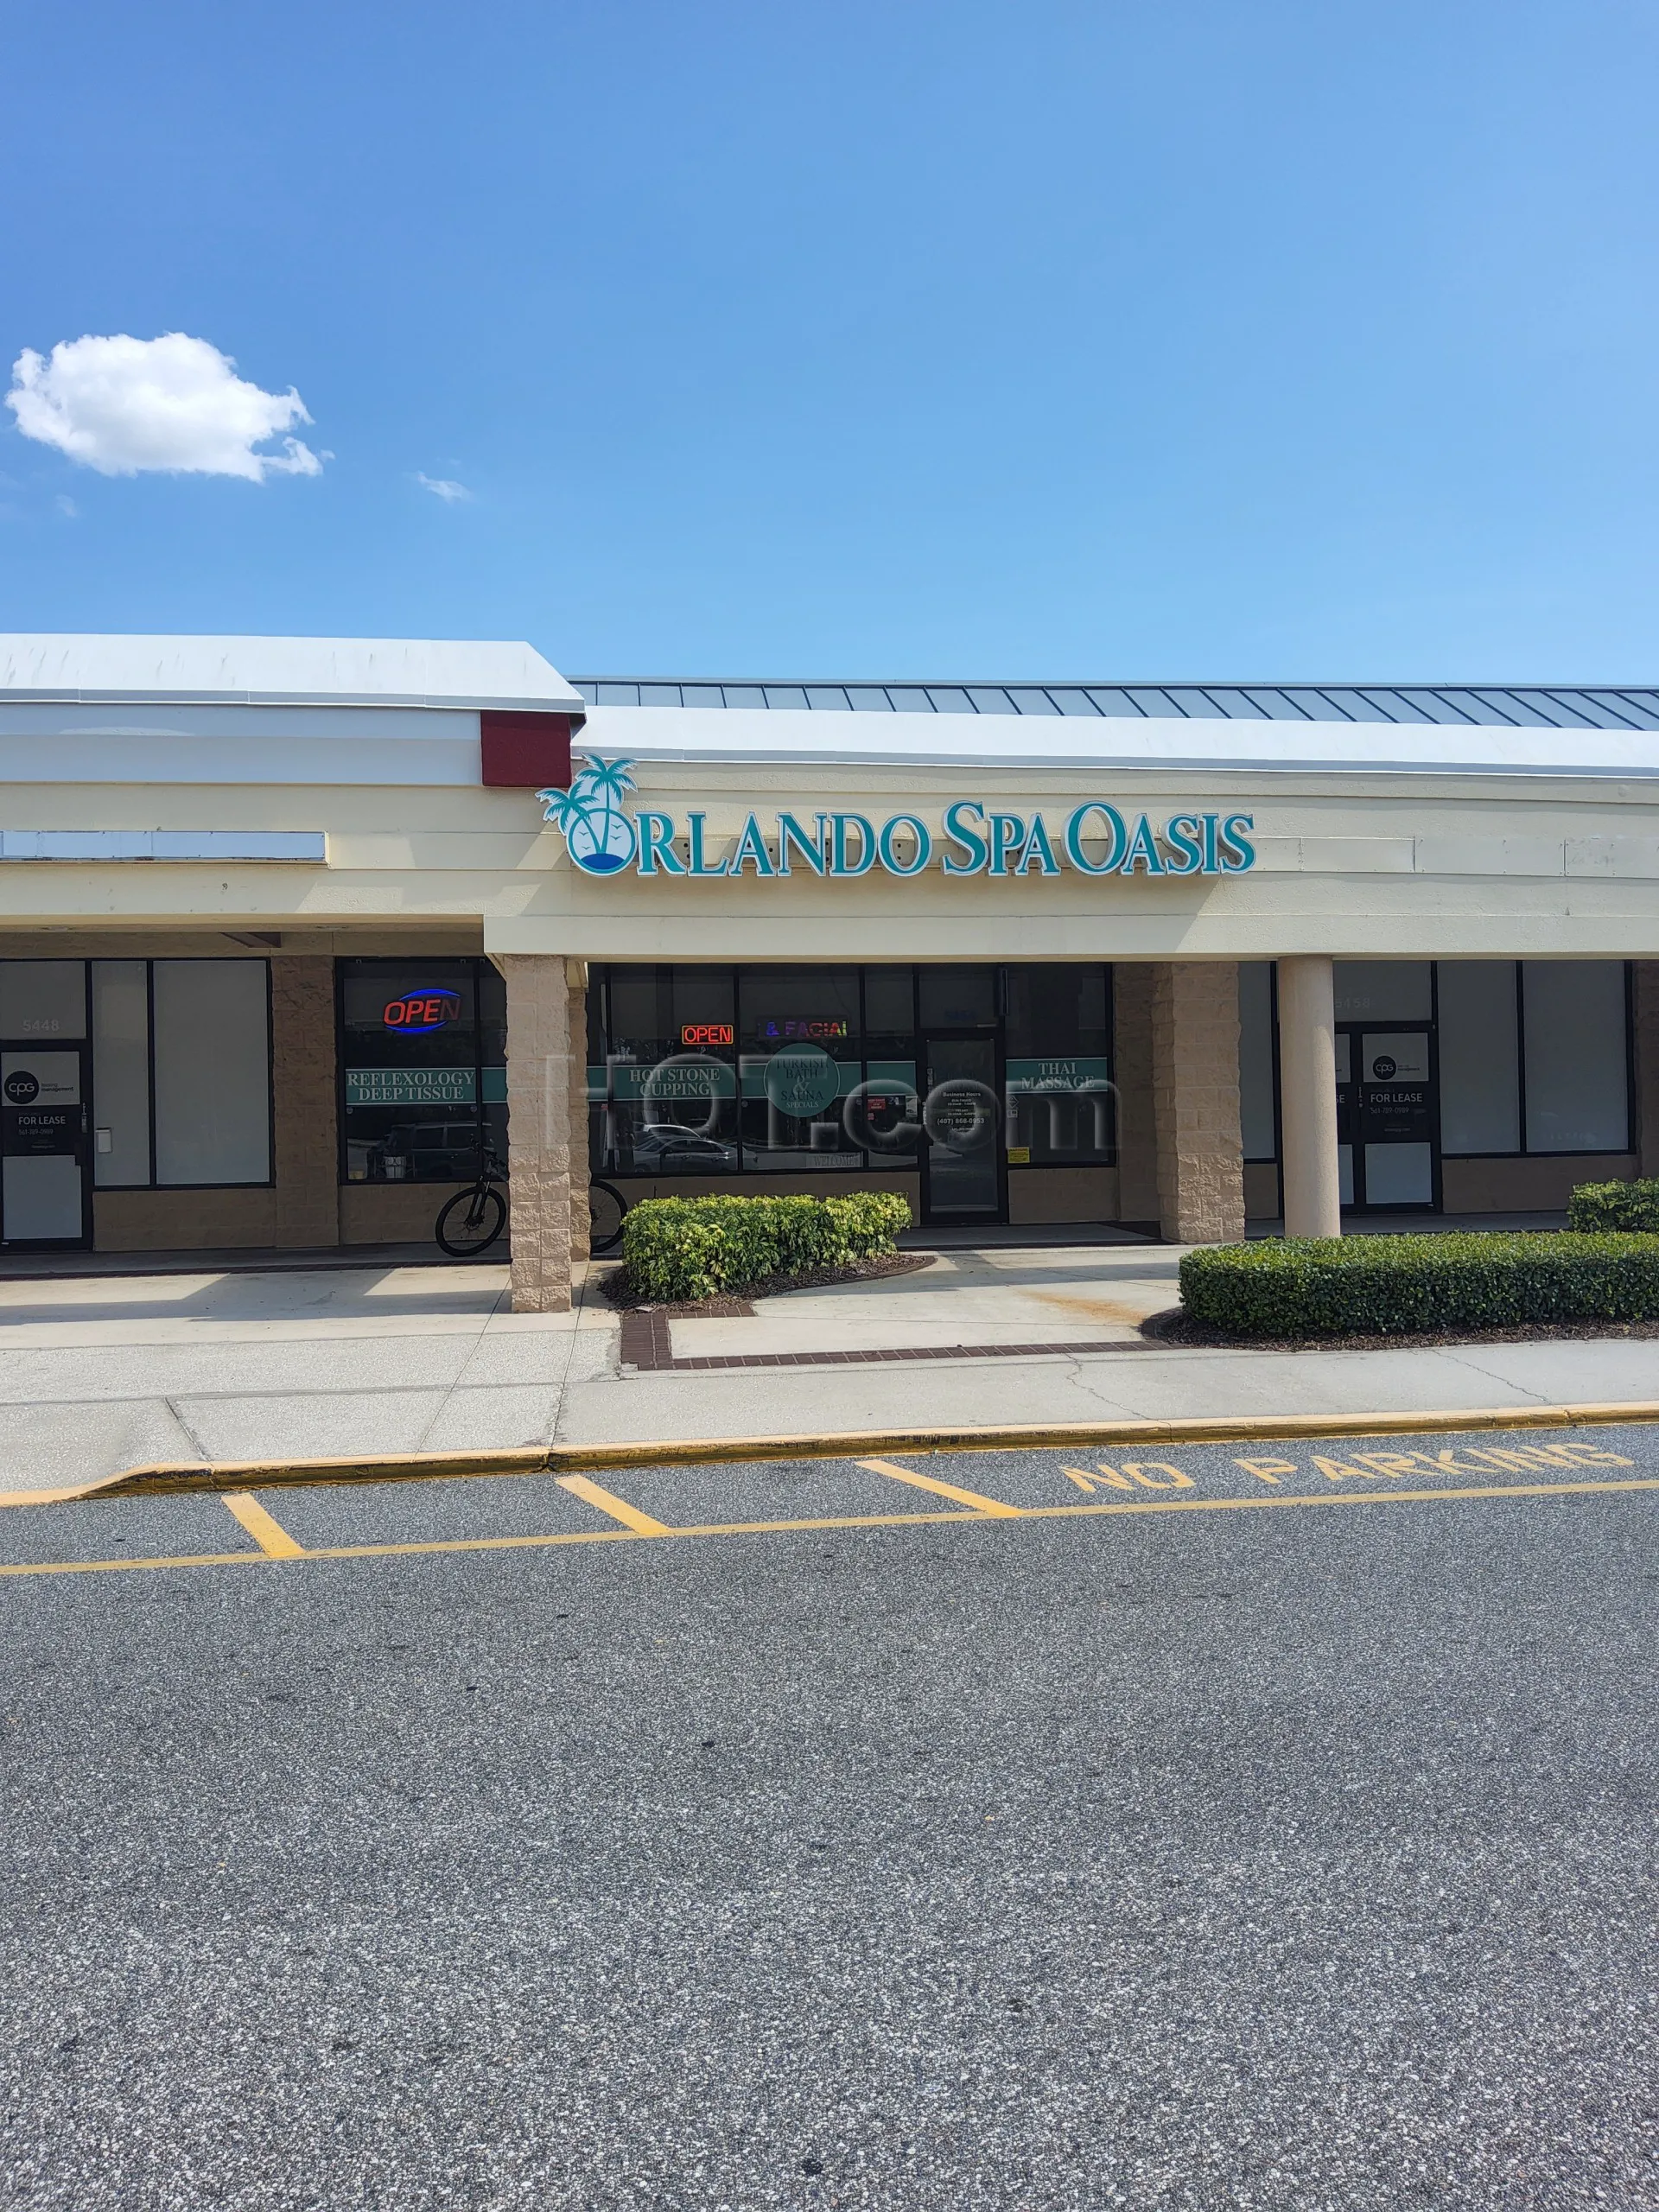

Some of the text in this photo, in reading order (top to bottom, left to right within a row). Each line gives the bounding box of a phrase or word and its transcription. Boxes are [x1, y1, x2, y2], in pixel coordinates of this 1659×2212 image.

[942, 799, 1062, 878] SPA
[1062, 798, 1258, 877] OASIS
[383, 999, 461, 1025] OPEN
[22, 1020, 60, 1032] 5448
[684, 1027, 732, 1043] OPEN
[775, 1058, 830, 1069] TURKISH
[1038, 1062, 1077, 1075] THAI
[347, 1071, 474, 1086] REFLEXOLOGY
[630, 1068, 721, 1082] HOT STONE
[785, 1068, 817, 1079] BATH
[639, 1082, 711, 1096] CUPPING
[1020, 1075, 1095, 1090] MASSAGE
[359, 1086, 464, 1101] DEEP TISSUE
[780, 1090, 824, 1101] SAUNA
[1370, 1093, 1423, 1103] FOR LEASE
[18, 1116, 67, 1125] FOR LEASE
[1058, 1442, 1636, 1492] NO PARKING
